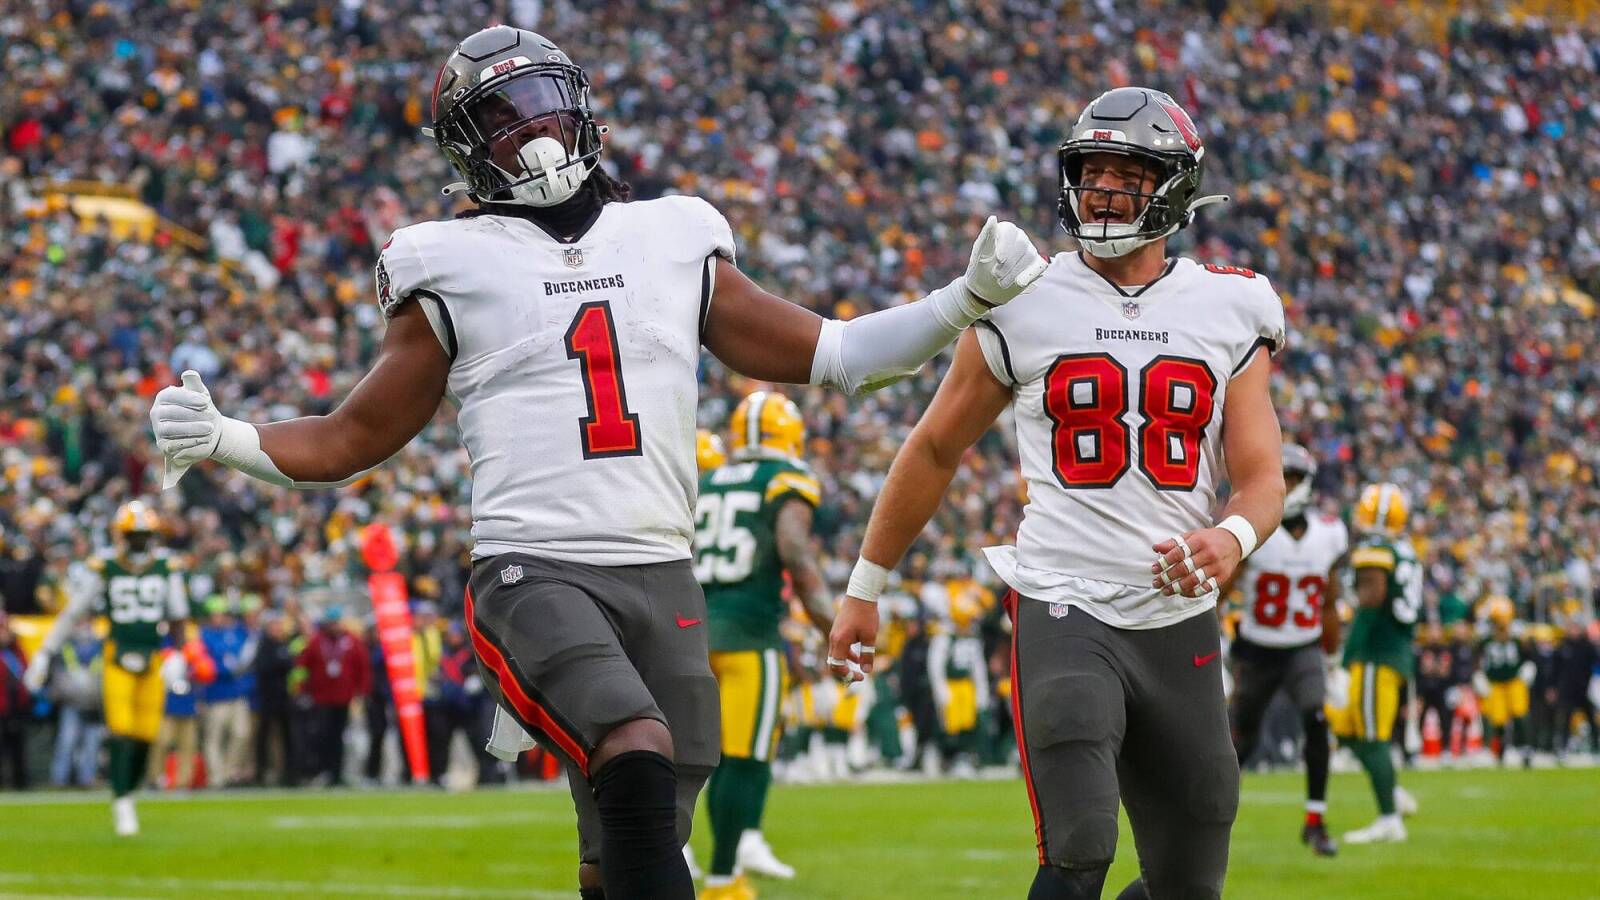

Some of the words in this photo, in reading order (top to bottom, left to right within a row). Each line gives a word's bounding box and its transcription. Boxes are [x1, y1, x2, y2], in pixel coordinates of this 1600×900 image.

[543, 273, 625, 296] BUCCANEERS
[1095, 327, 1169, 344] BUCCANEERS
[564, 299, 644, 461] 1
[1042, 351, 1219, 492] 88
[109, 574, 164, 623] 59
[1253, 571, 1325, 629] 83
